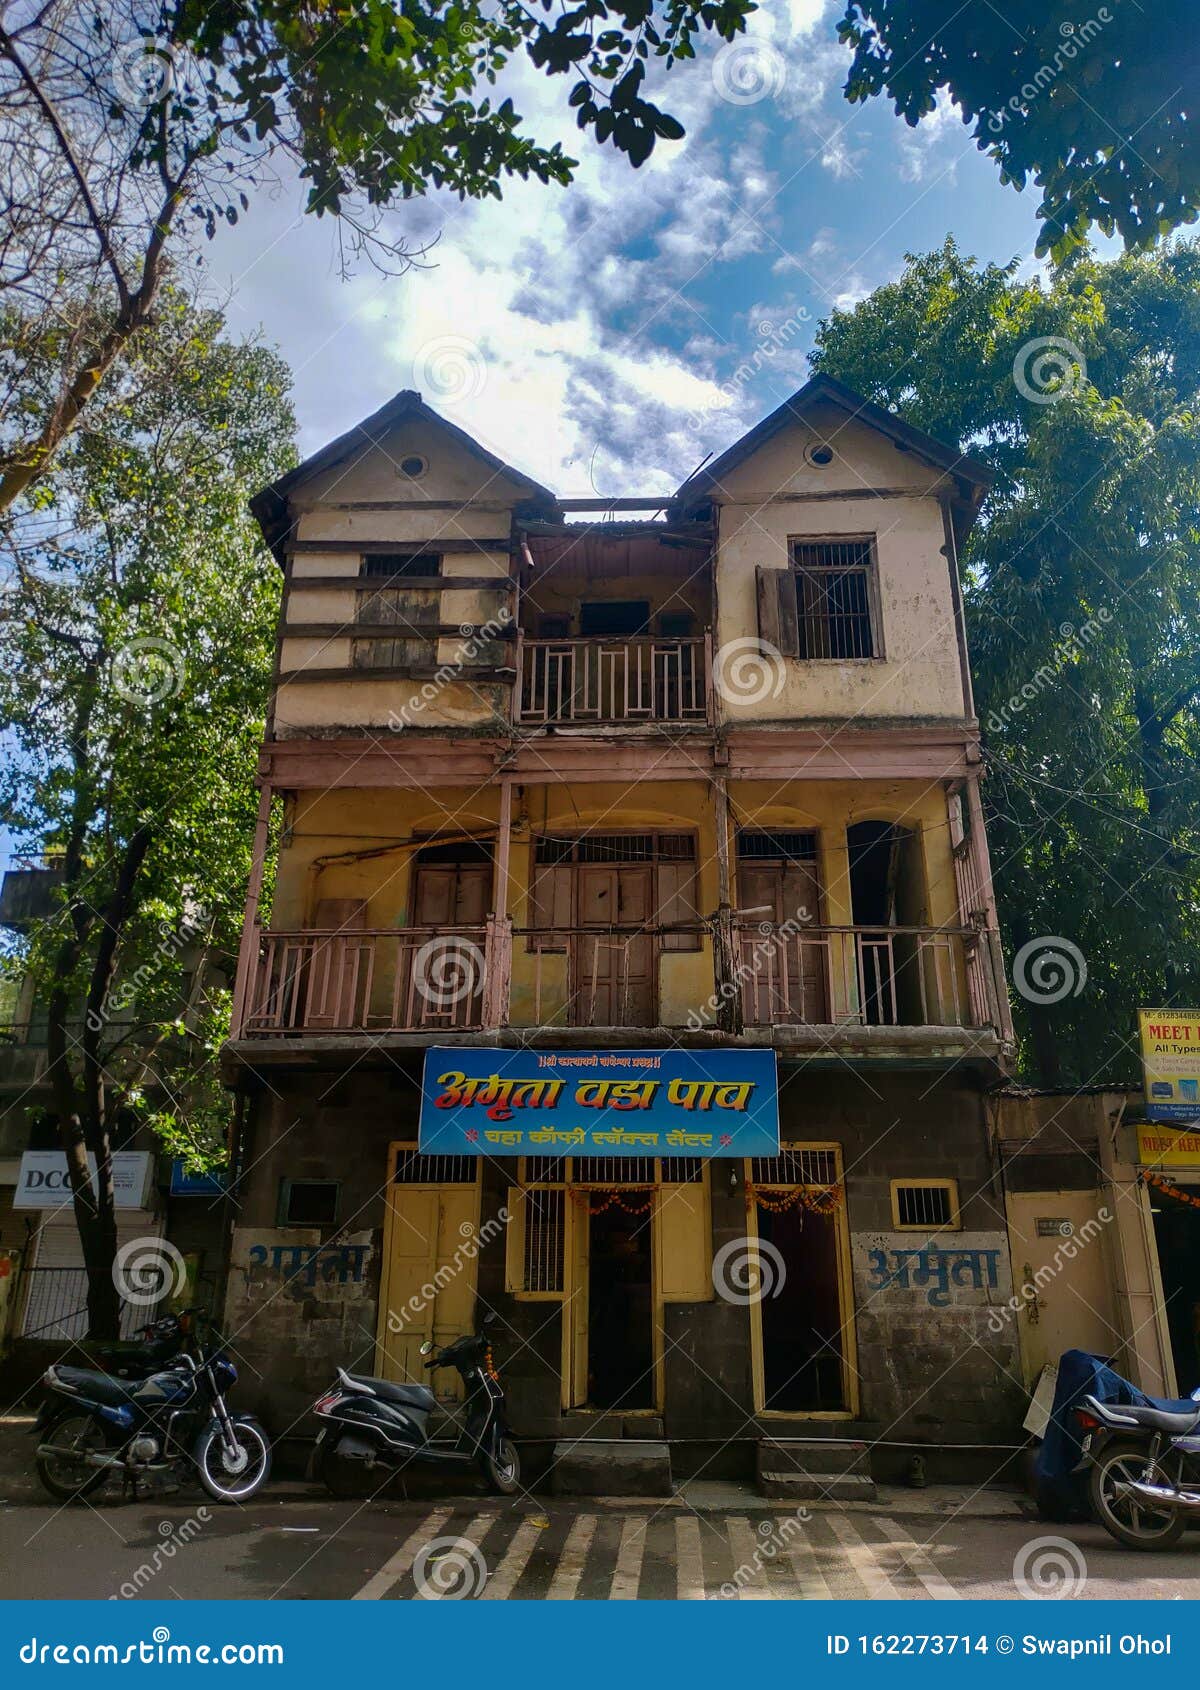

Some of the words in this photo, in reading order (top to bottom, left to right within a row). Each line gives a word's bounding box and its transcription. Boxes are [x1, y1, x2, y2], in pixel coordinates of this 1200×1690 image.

[1149, 1025, 1192, 1040] MEET
[1155, 1044, 1169, 1053] All
[433, 1071, 566, 1121] अमृता
[574, 1079, 661, 1110] वडा
[667, 1077, 756, 1112] पाव
[484, 1130, 523, 1146] चहा
[528, 1126, 585, 1145] कॉफी
[665, 1128, 713, 1147] सेंटर
[1142, 1136, 1173, 1151] MEET
[867, 1242, 1000, 1307] अमृता
